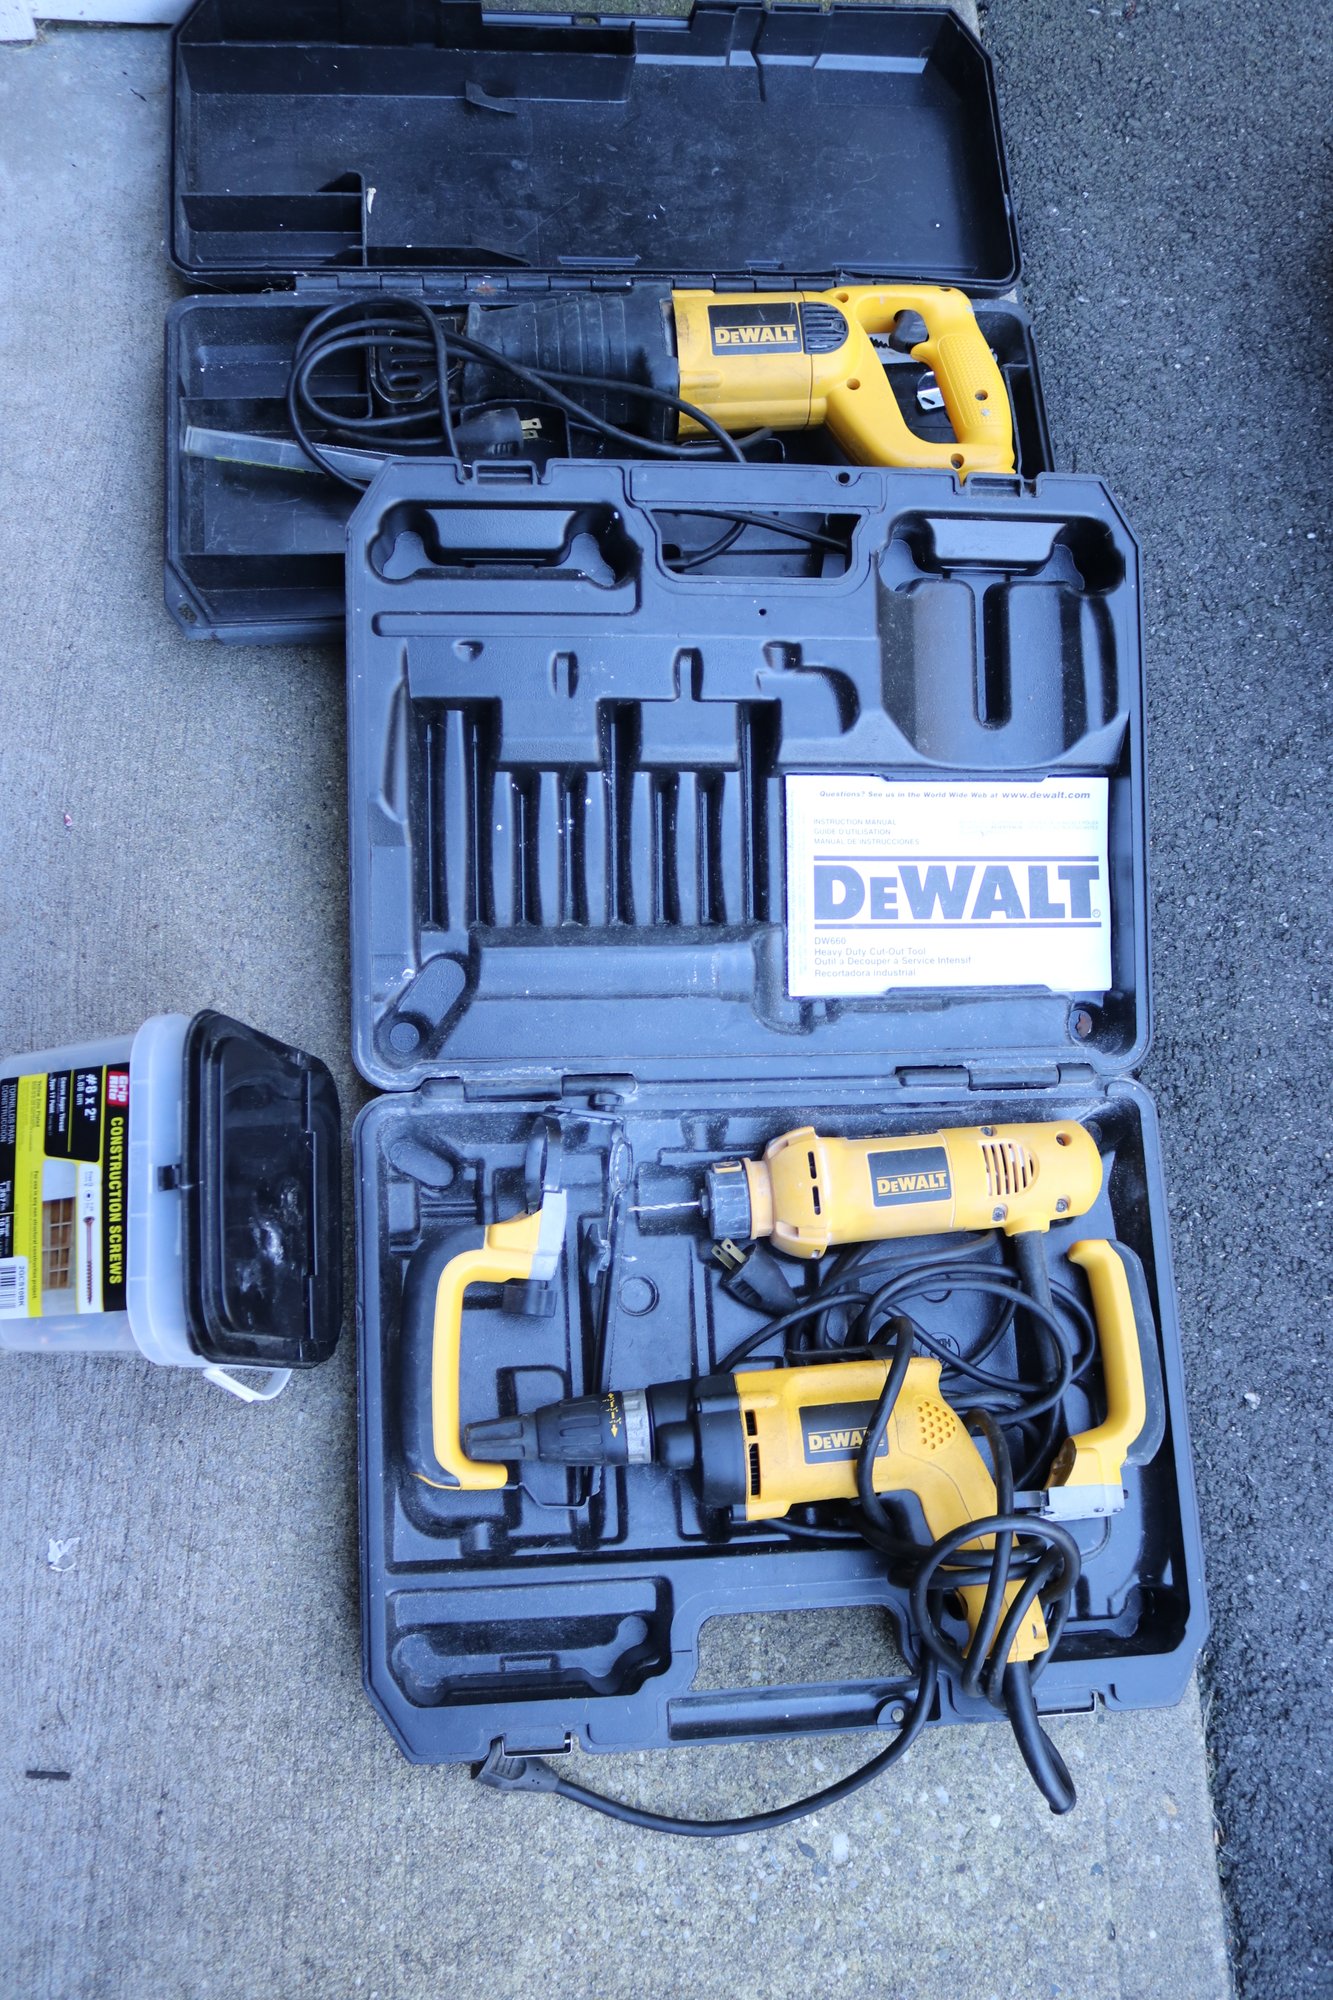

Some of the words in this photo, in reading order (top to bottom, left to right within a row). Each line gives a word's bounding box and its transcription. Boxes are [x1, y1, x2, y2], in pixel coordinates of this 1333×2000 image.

[1002, 791, 1090, 799] www.dewalt.com
[814, 948, 842, 957] Heavy
[846, 948, 866, 957] Duty
[870, 948, 904, 956] Cut-Out
[84, 1074, 98, 1093] #8
[84, 1108, 96, 1121] 2"
[109, 1116, 124, 1222] CONSTRUCTION
[109, 1226, 122, 1284] SCREWS
[808, 1430, 884, 1450] DEWA
